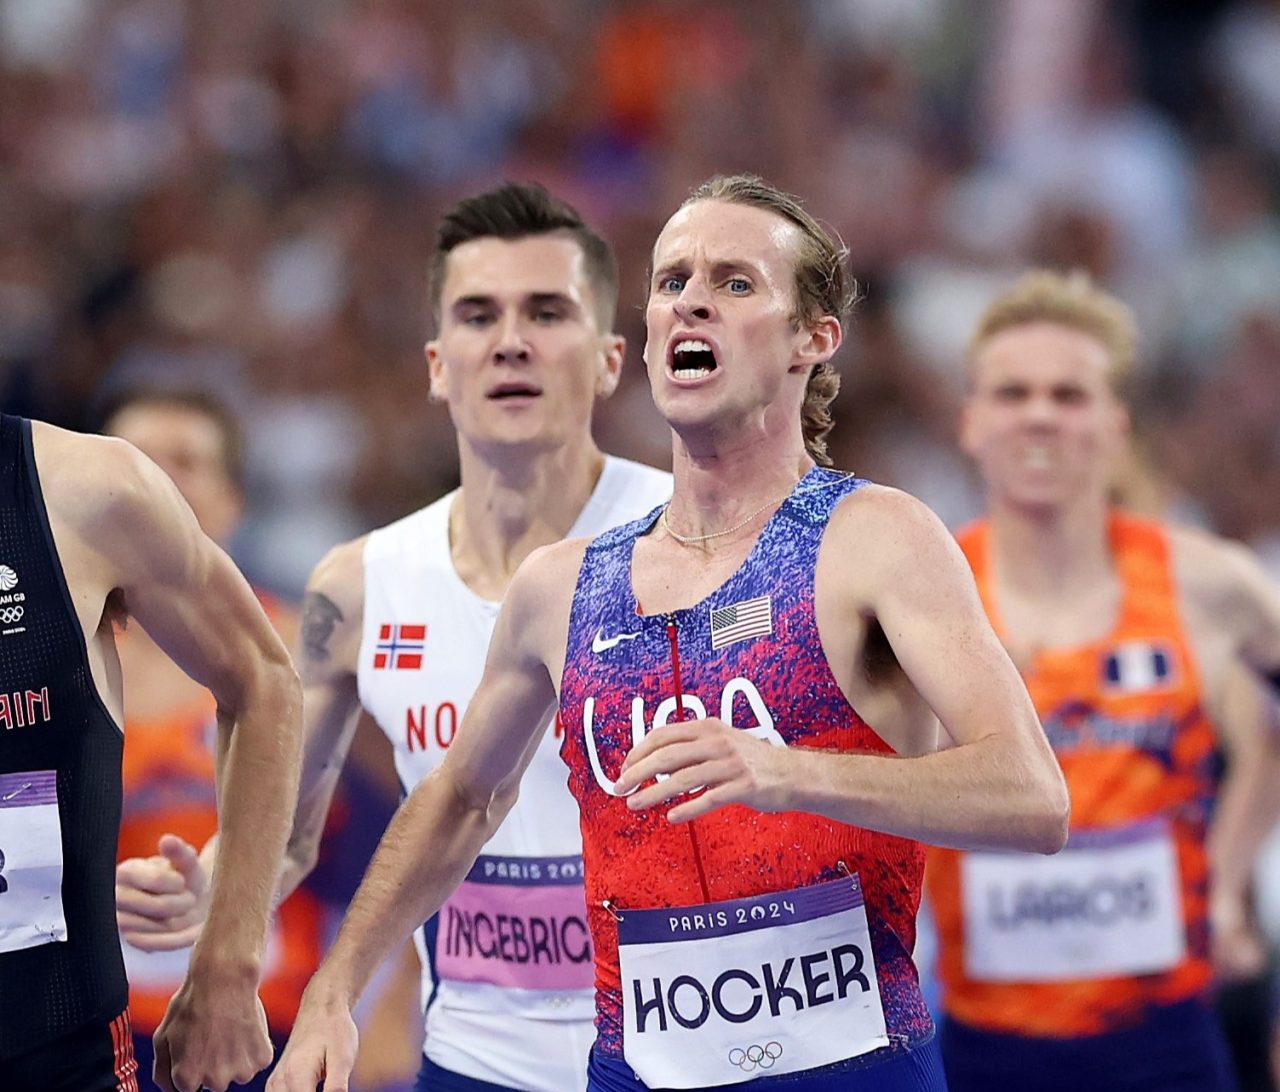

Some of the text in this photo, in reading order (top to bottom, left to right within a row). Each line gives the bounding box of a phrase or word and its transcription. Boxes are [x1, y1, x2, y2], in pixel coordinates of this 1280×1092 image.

[13, 592, 26, 603] GB
[484, 861, 584, 880] PARIS 20
[669, 901, 796, 932] PARIS 2024
[632, 943, 871, 1034] HOCKER
